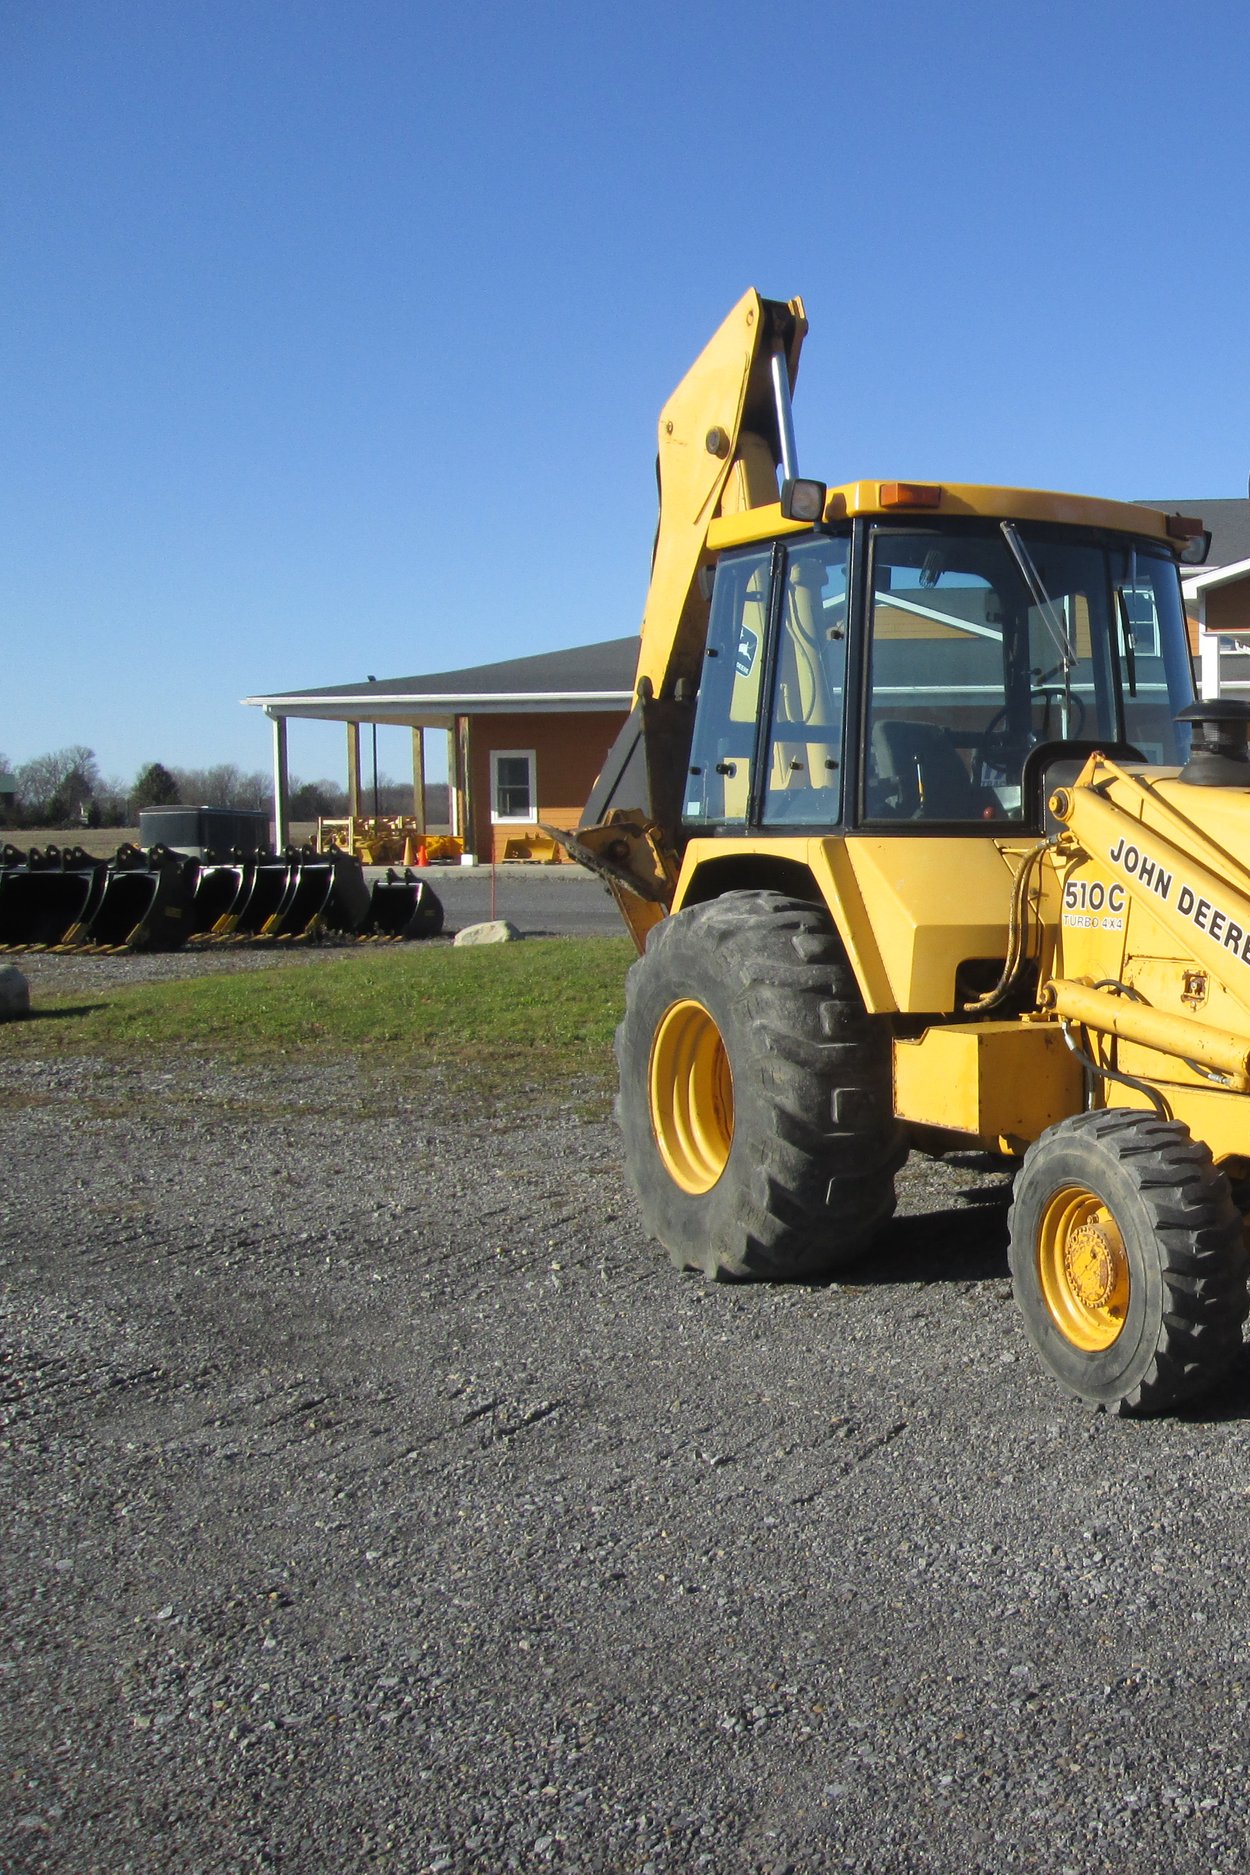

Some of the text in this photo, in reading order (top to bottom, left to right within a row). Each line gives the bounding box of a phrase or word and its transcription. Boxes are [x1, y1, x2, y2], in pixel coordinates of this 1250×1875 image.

[1110, 838, 1173, 900] JOHN
[1065, 882, 1124, 912] 510C
[1063, 915, 1099, 928] TURBO
